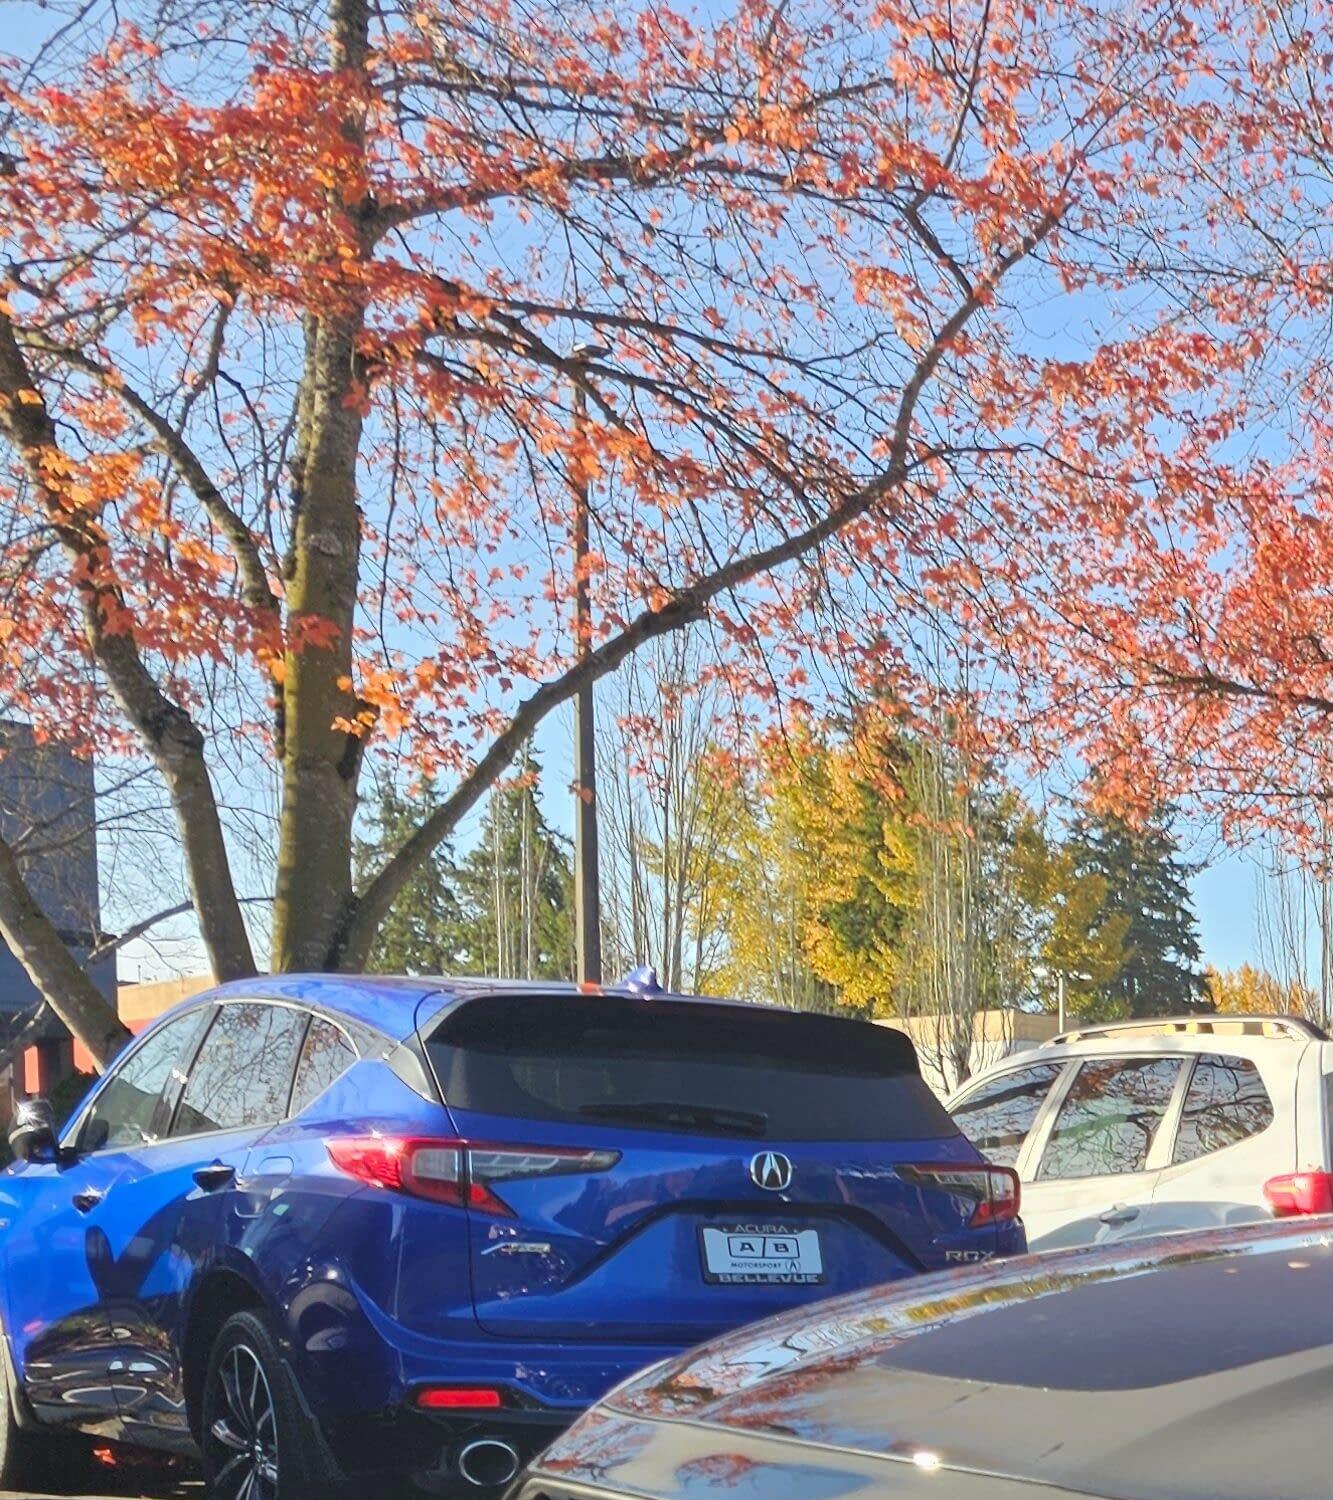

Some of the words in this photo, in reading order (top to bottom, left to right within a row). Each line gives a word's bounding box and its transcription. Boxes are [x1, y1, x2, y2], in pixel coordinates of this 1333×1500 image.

[735, 1224, 788, 1233] ACURA
[945, 1250, 995, 1262] RDX
[719, 1274, 819, 1283] BELLEVUE
